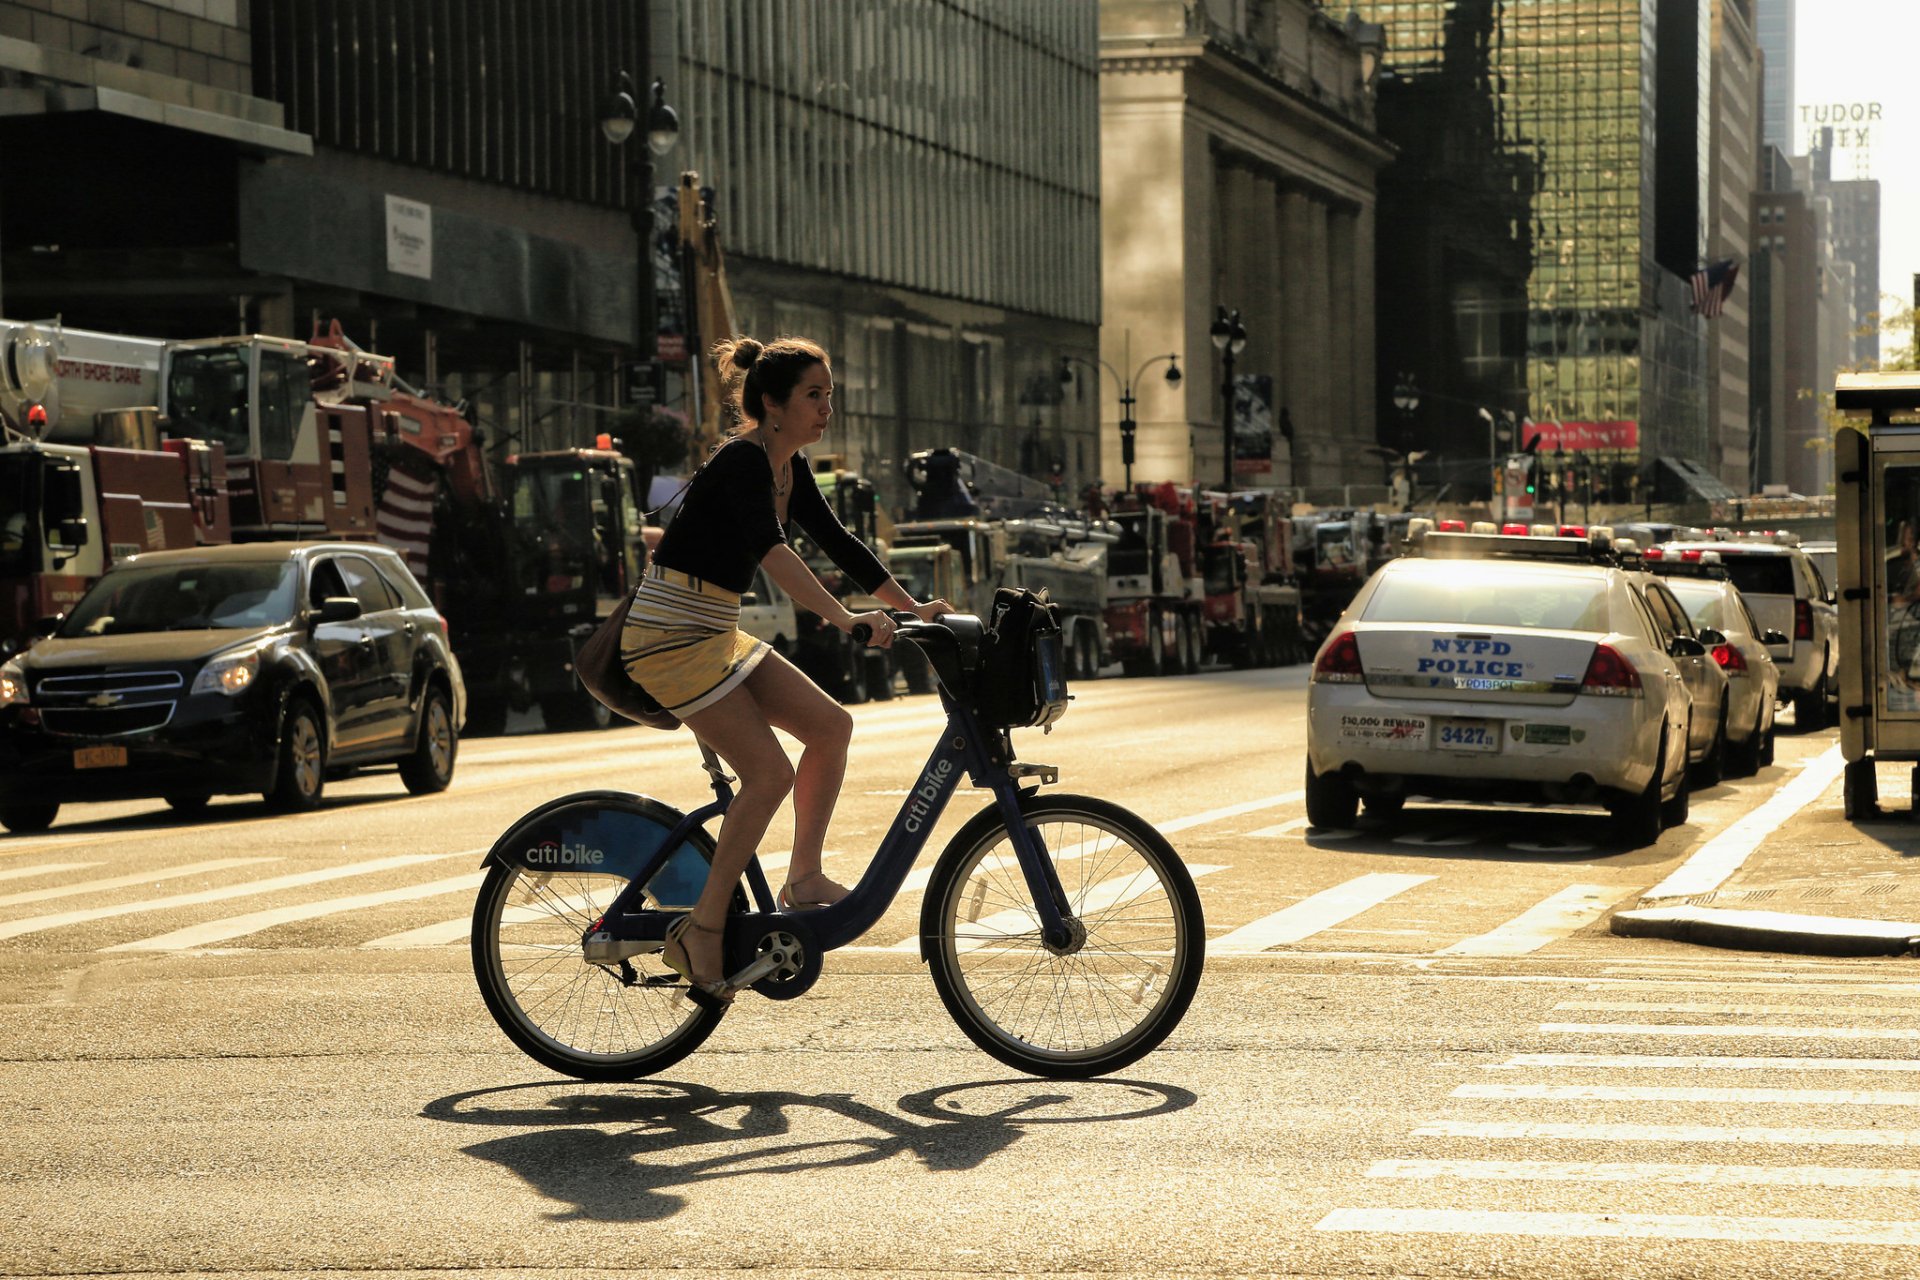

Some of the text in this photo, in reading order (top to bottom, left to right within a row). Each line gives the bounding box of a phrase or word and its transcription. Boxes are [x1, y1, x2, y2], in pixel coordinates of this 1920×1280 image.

[1799, 102, 1882, 123] TUDOR
[1813, 127, 1869, 147] CTY
[84, 362, 112, 382] SHORE
[114, 366, 142, 385] CRANE
[1432, 638, 1512, 656] NYPD
[1417, 657, 1523, 678] POLICE
[1341, 715, 1380, 728] $10,000
[1383, 717, 1426, 730] REWARD
[1440, 726, 1487, 745] 3427
[905, 759, 953, 833] citi bike
[526, 843, 604, 865] citi bike
